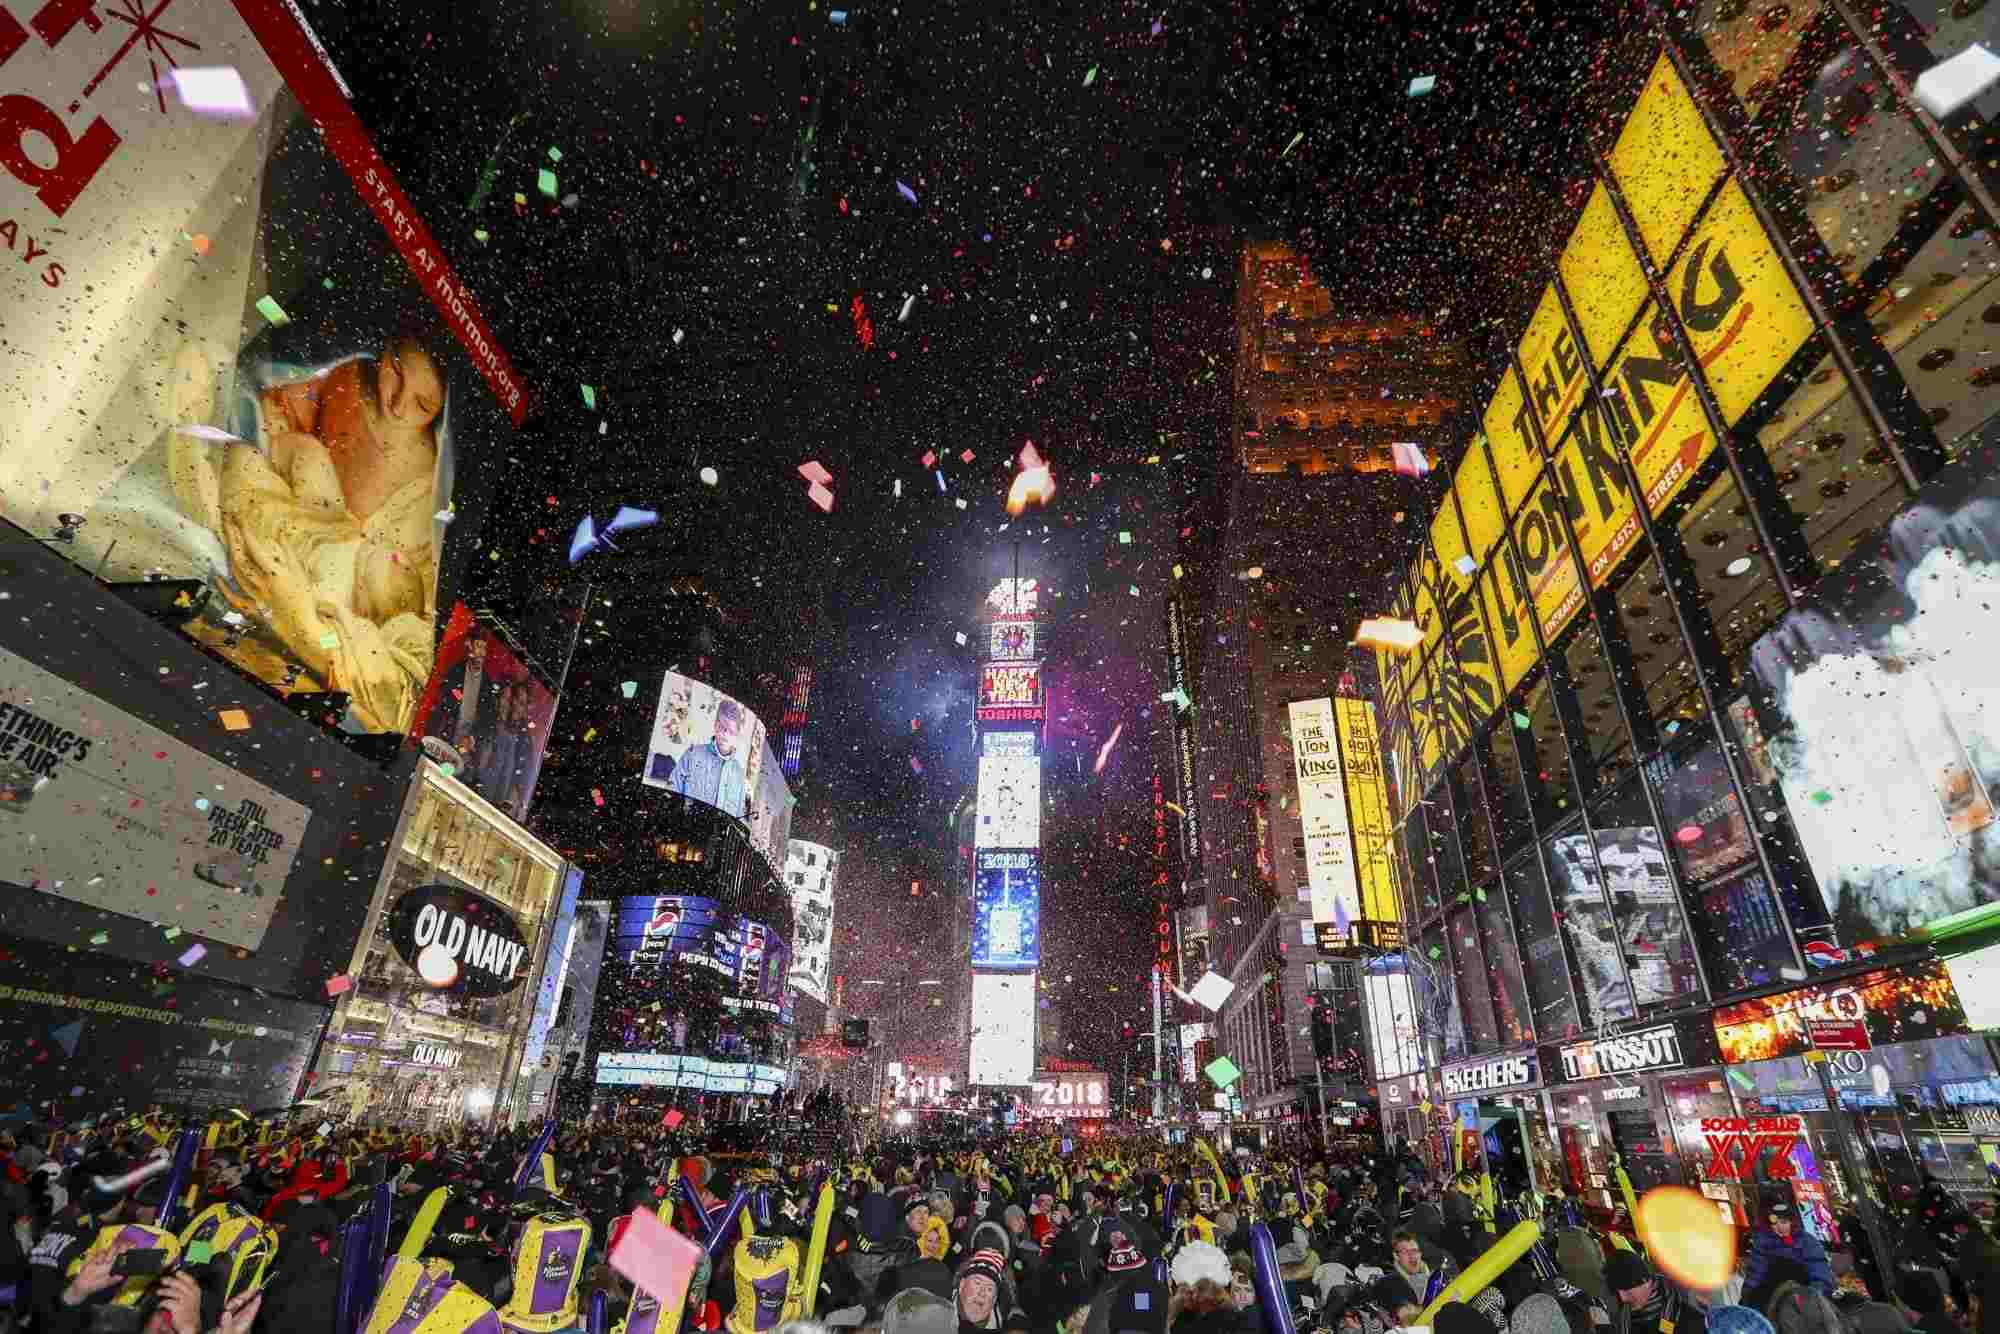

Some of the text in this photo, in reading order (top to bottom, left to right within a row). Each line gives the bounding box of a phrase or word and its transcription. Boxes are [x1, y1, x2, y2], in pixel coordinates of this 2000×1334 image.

[365, 168, 521, 407] START AT mormon.org
[1513, 327, 1582, 454] THE
[1482, 237, 1745, 650] LION KING
[1592, 552, 1609, 576] ON
[1647, 457, 1685, 509] STREET
[976, 708, 1043, 721] TOSHIBA
[1298, 757, 1338, 778] KING
[414, 904, 526, 979] OLD NAVY
[412, 1045, 463, 1067] OLD NAVY
[1596, 1027, 1676, 1073] TISSOT
[1038, 1080, 1107, 1105] 2018
[1443, 1056, 1529, 1095] SKECHERS
